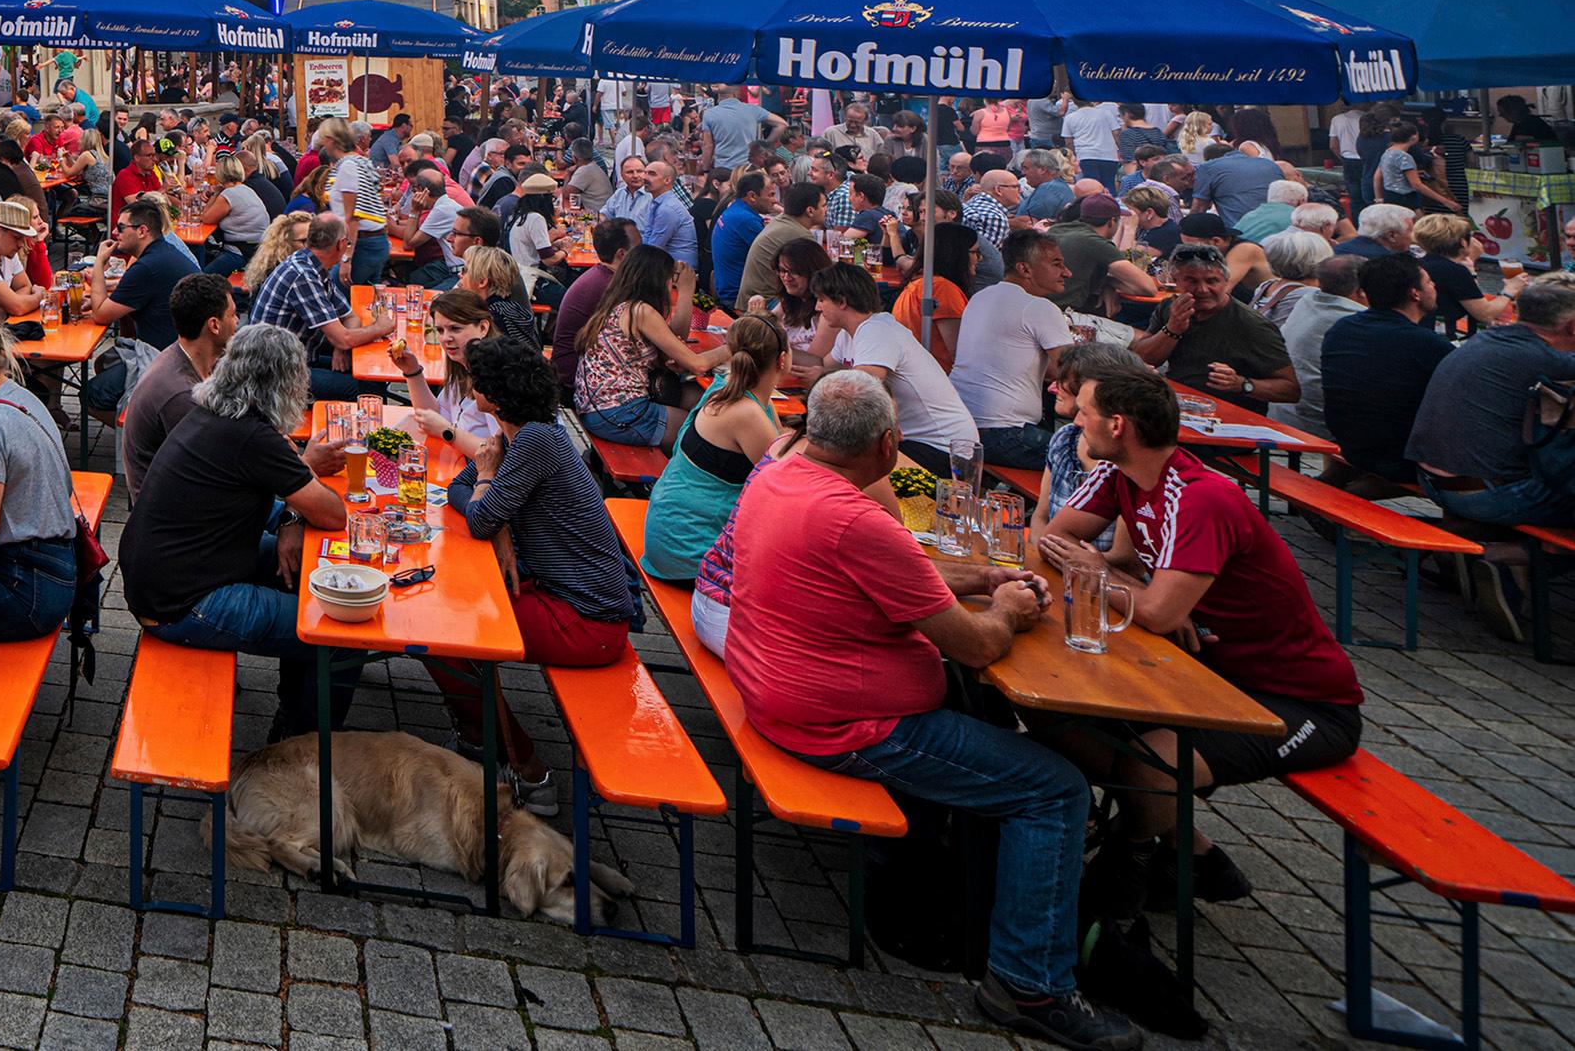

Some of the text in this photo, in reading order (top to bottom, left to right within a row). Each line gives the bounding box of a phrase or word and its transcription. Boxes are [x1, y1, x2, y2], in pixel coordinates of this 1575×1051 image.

[217, 23, 285, 49] Hofmühl
[308, 31, 378, 48] Hofmühl
[704, 53, 718, 63] seit
[777, 36, 1024, 91] Hofmühl
[1079, 61, 1307, 83] Eichstätter Braukunst seit 1492
[1344, 49, 1407, 93] fmühl
